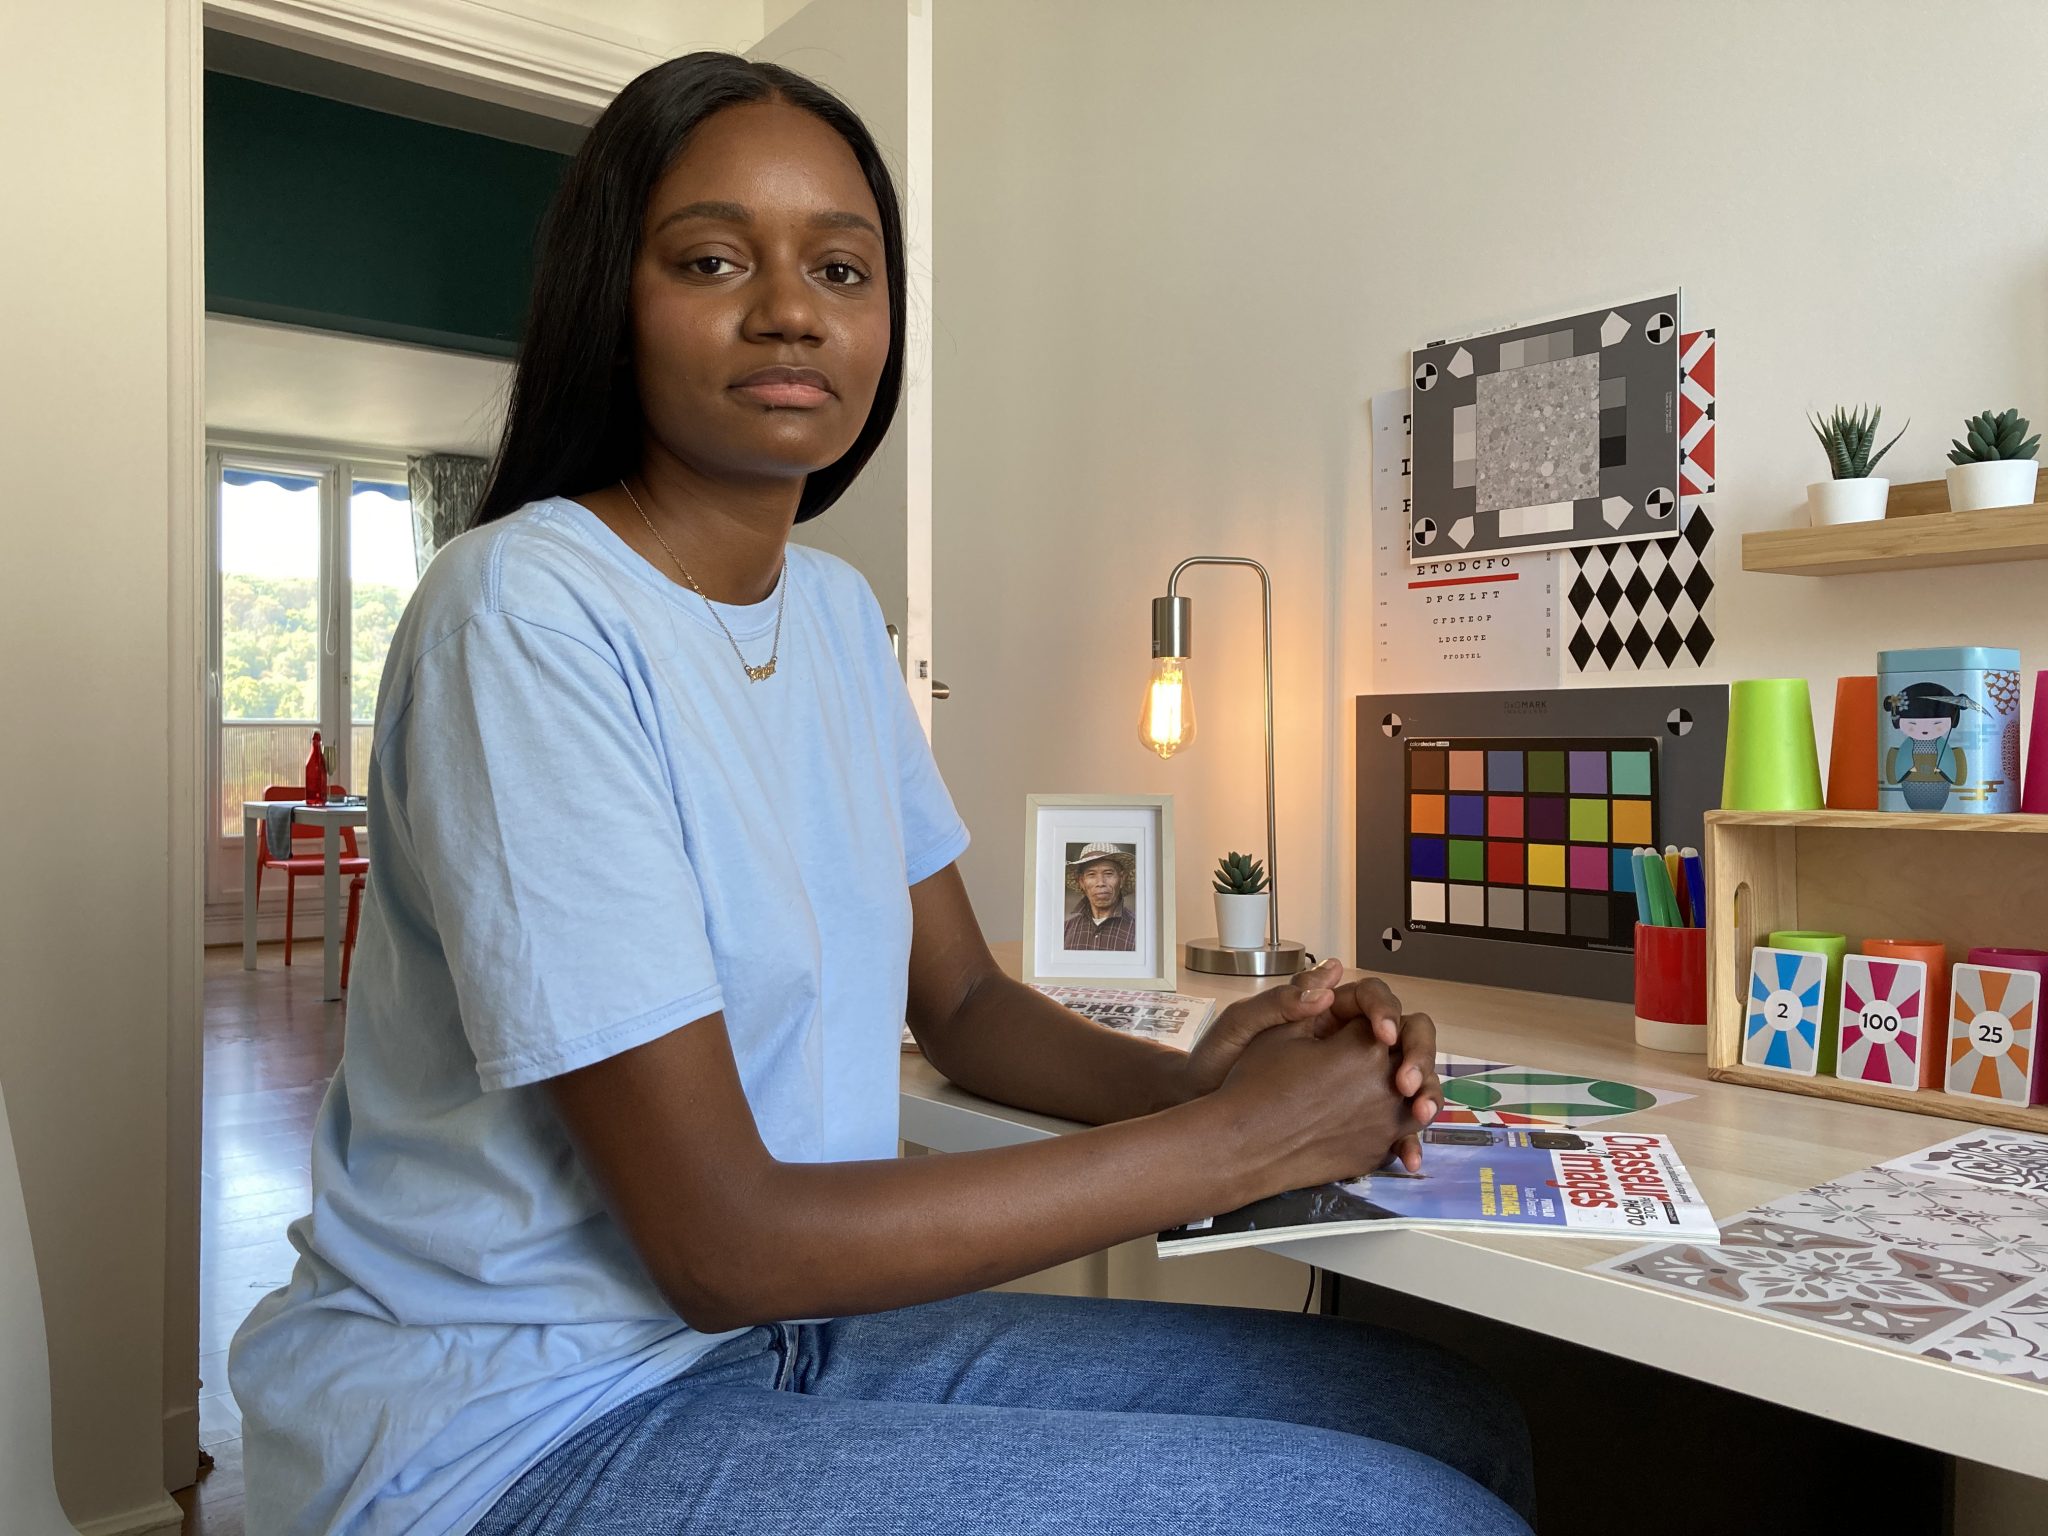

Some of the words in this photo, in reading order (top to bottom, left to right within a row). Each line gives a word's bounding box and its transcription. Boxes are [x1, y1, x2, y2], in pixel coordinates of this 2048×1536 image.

[1417, 557, 1510, 575] ETODCFO
[1426, 591, 1500, 603] DPCZLFT
[1064, 1003, 1191, 1018] PHOTO
[1777, 1003, 1788, 1019] 2
[1862, 1013, 1898, 1032] 100
[1978, 1025, 2003, 1044] 25
[1603, 1136, 1672, 1203] Chasseur
[1621, 1198, 1646, 1226] PHOTO
